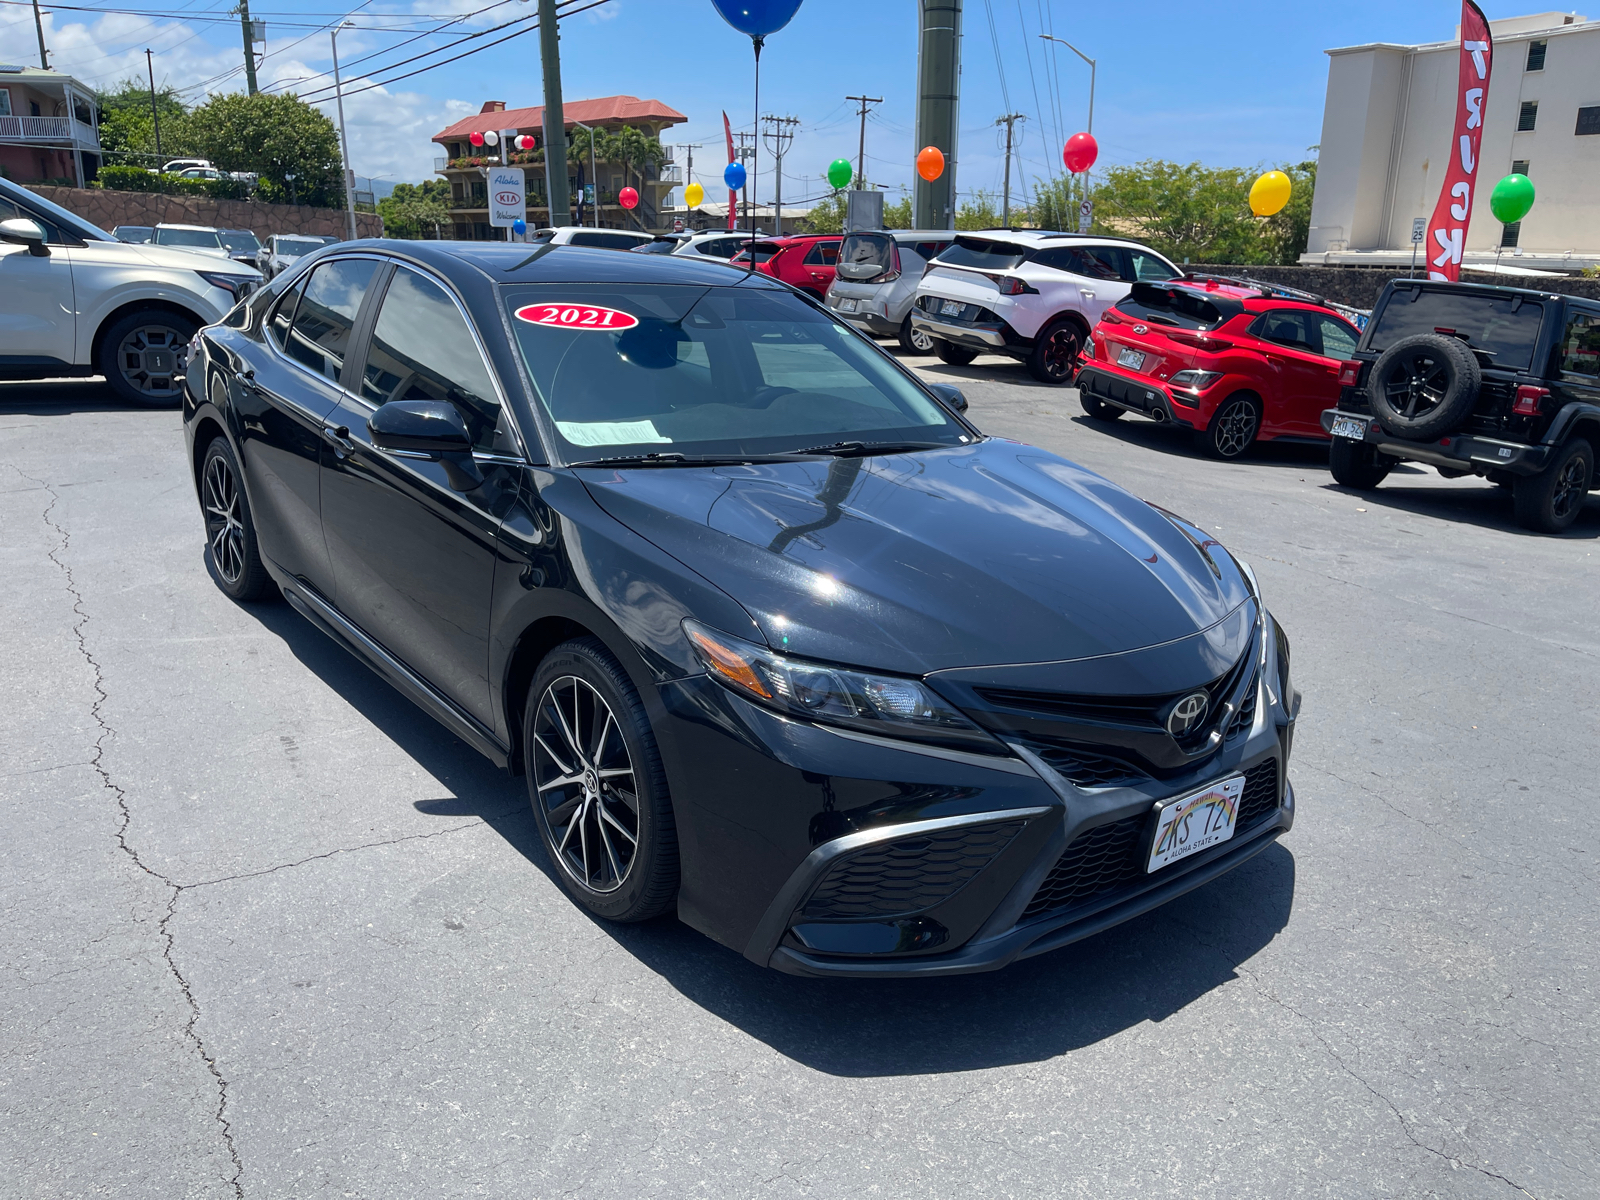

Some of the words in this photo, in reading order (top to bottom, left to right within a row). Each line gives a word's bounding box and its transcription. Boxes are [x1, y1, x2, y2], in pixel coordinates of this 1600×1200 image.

[1430, 40, 1489, 281] TRUCK
[494, 174, 520, 186] Aloha
[499, 194, 517, 203] KIA
[496, 210, 522, 220] Welcome!
[1412, 230, 1423, 240] 25
[539, 307, 615, 326] 2021
[1189, 791, 1214, 808] HAWAII
[1155, 811, 1194, 857] ZKS
[1203, 793, 1239, 836] 727
[1170, 845, 1192, 859] ALOHA
[1192, 835, 1213, 849] STATE
